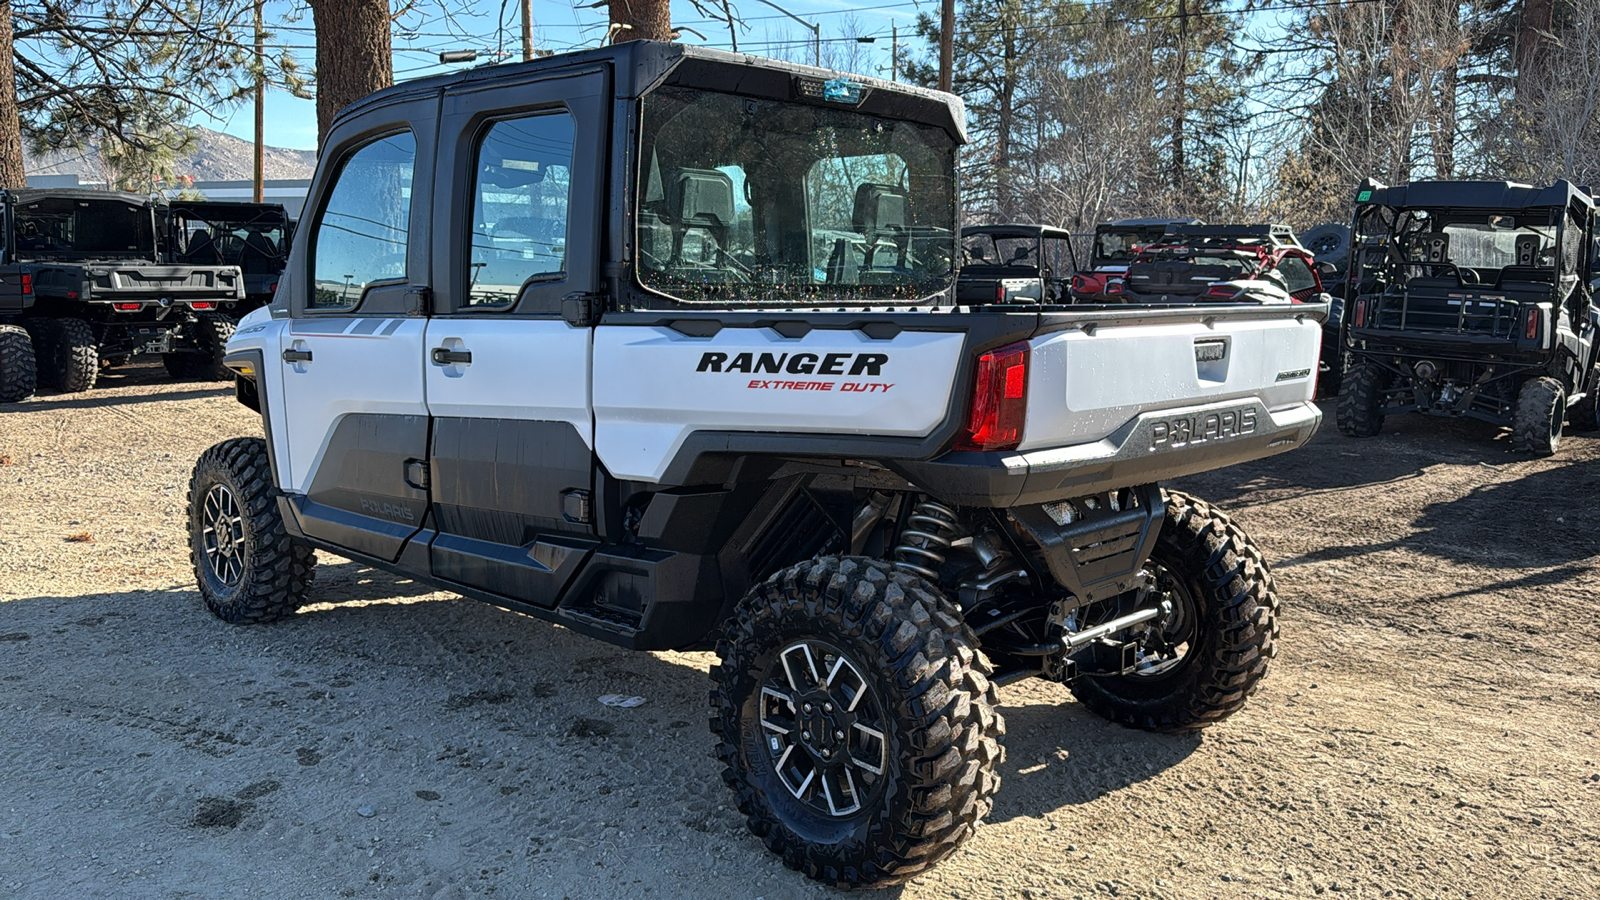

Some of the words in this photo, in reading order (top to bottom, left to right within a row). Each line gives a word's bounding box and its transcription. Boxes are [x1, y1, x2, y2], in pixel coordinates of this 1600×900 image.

[695, 352, 889, 376] RANGER
[747, 380, 835, 391] EXTREME
[840, 382, 895, 393] DUTY
[1149, 407, 1257, 452] POLARIS
[361, 499, 414, 520] POLARIS
[740, 718, 767, 777] KENDA
